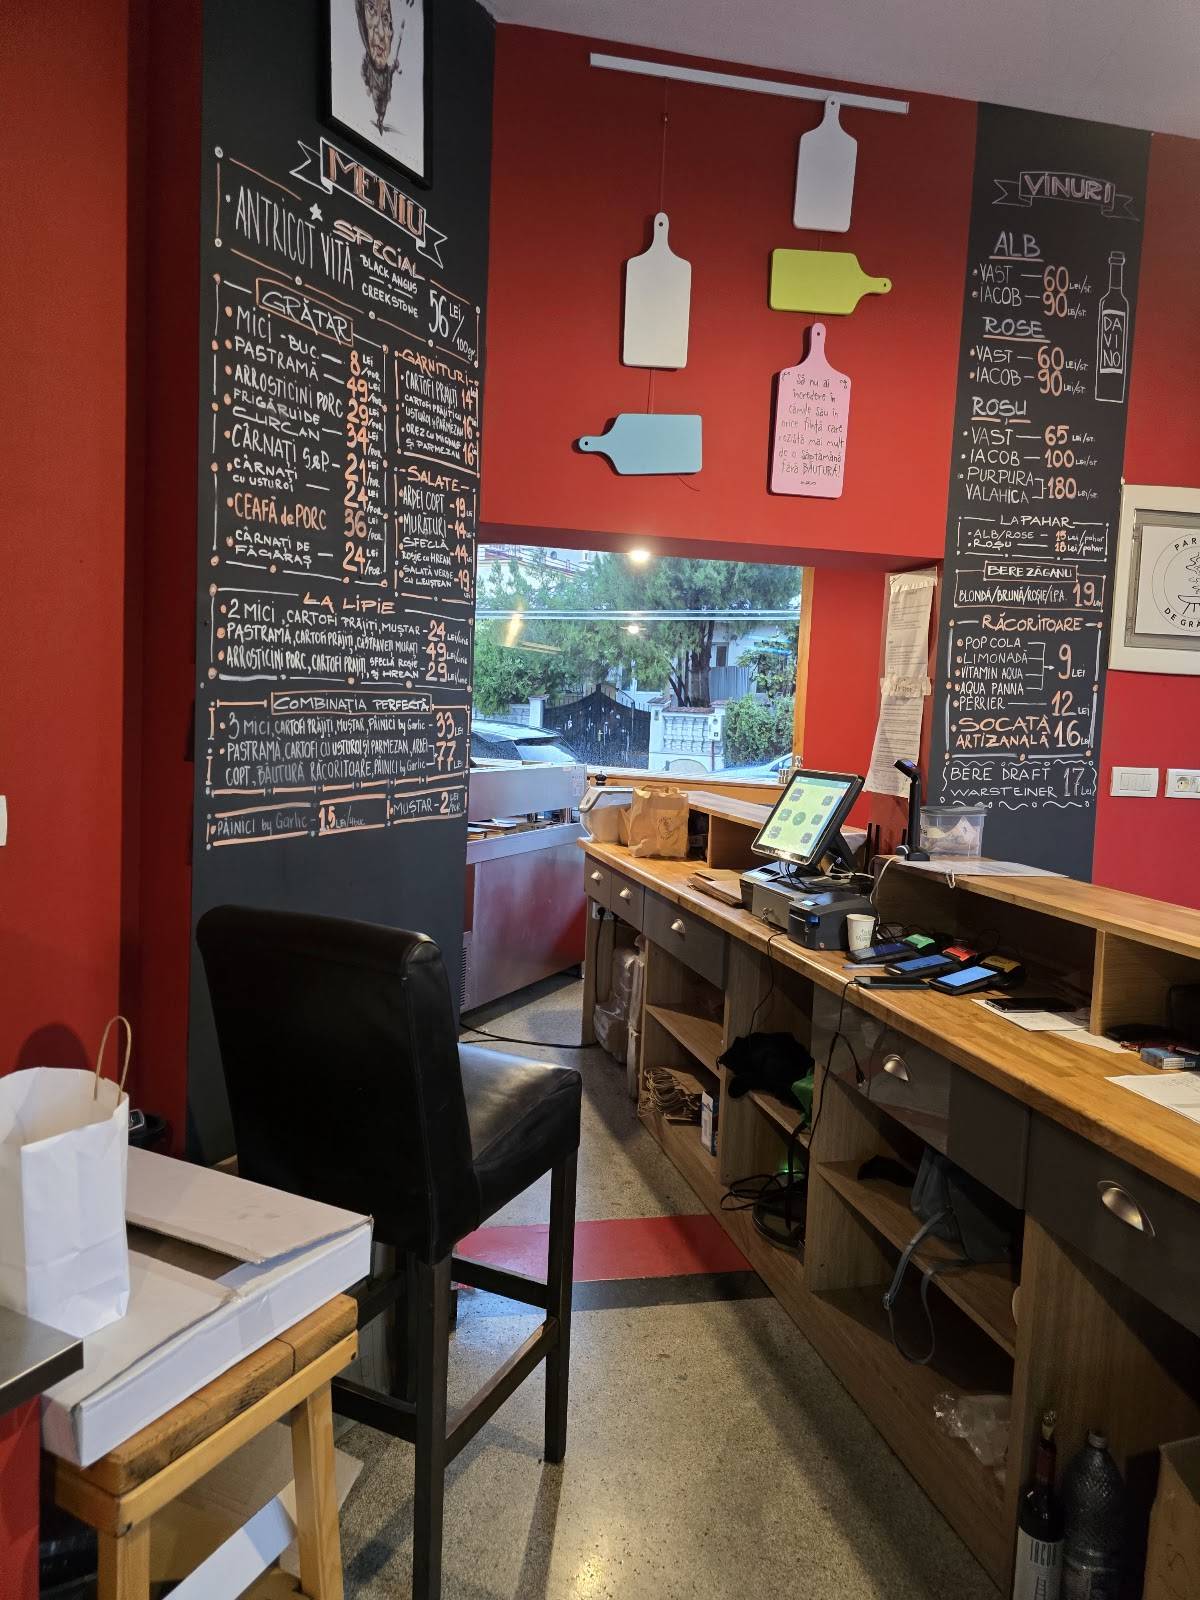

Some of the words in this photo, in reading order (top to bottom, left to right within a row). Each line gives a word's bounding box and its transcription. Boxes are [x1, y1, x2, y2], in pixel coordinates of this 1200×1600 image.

[328, 146, 425, 236] MENIU
[1024, 173, 1111, 203] VINURI
[235, 185, 315, 269] ANTRICOT
[333, 219, 425, 281] SPECIAL
[994, 231, 1040, 258] ALB
[360, 254, 390, 280] BLACK
[979, 263, 1013, 284] VAST
[1043, 265, 1069, 292] 60
[391, 273, 418, 294] ANGUS
[362, 283, 419, 318] CREEKSTONE
[980, 282, 1022, 307] IACOB
[1043, 291, 1067, 317] 90
[428, 289, 449, 338] 56
[1104, 317, 1122, 331] DA
[982, 316, 1046, 338] ROSE
[237, 305, 272, 344] MICI
[350, 350, 361, 376] 8
[1104, 334, 1118, 348] VI
[976, 345, 1013, 363] VAST
[1037, 346, 1064, 370] 60
[1103, 351, 1120, 366] NO
[347, 376, 368, 403] 49
[976, 367, 1021, 386] IACOB
[1038, 369, 1063, 396] 90
[235, 364, 313, 409] ARROSTICINI
[317, 391, 343, 418] PORC
[347, 398, 369, 426] 29
[462, 388, 473, 411] 14
[233, 406, 320, 441] CURCAN
[347, 423, 369, 455] 34
[971, 426, 1014, 446] VAST
[1045, 425, 1069, 446] 65
[345, 453, 366, 485] 21
[970, 449, 1020, 466] IACOB
[1045, 449, 1075, 468] 100
[408, 465, 461, 491] SALATE
[967, 467, 1033, 486] PURPURA
[1047, 476, 1076, 499] 180
[233, 475, 245, 483] CU
[249, 476, 294, 492] USTUROI
[344, 481, 368, 511] 24
[966, 483, 1029, 504] VALAHICA
[455, 497, 466, 518] 19
[296, 504, 327, 531] PORC
[344, 508, 367, 538] 36
[1000, 514, 1019, 525] LA
[1021, 516, 1075, 528] PAHAR
[297, 542, 310, 551] DE
[343, 541, 365, 574] 24
[988, 565, 1024, 578] BERE
[303, 592, 334, 613] LA
[343, 594, 396, 614] LIPIE
[1073, 582, 1095, 608] 19
[228, 599, 240, 618] 2
[287, 609, 338, 626] CARTOFI
[428, 620, 446, 641] 24
[1164, 608, 1177, 621] DE
[426, 642, 447, 661] 49
[966, 636, 987, 650] POP
[989, 637, 1021, 648] COLA
[227, 645, 283, 670] ARROSTICINI
[426, 662, 447, 682] 29
[961, 666, 998, 680] VITAMIN
[1001, 667, 1023, 679] AQUA
[1059, 644, 1072, 679] 9
[959, 683, 985, 698] AQUA
[992, 683, 1024, 695] PANNA
[1051, 690, 1076, 716] 12
[959, 697, 1006, 711] PERRIER
[229, 712, 240, 739] 3
[436, 712, 455, 739] 33
[1054, 720, 1080, 747] 16
[285, 741, 317, 759] CARTOFI
[320, 740, 330, 756] CU
[332, 739, 361, 755] USTUROI
[436, 741, 456, 771] 77
[951, 767, 992, 781] BERE
[1003, 767, 1050, 781] DRAFT
[1063, 767, 1084, 797] 17
[951, 787, 1058, 798] WARSTEINER
[440, 792, 449, 814] 2
